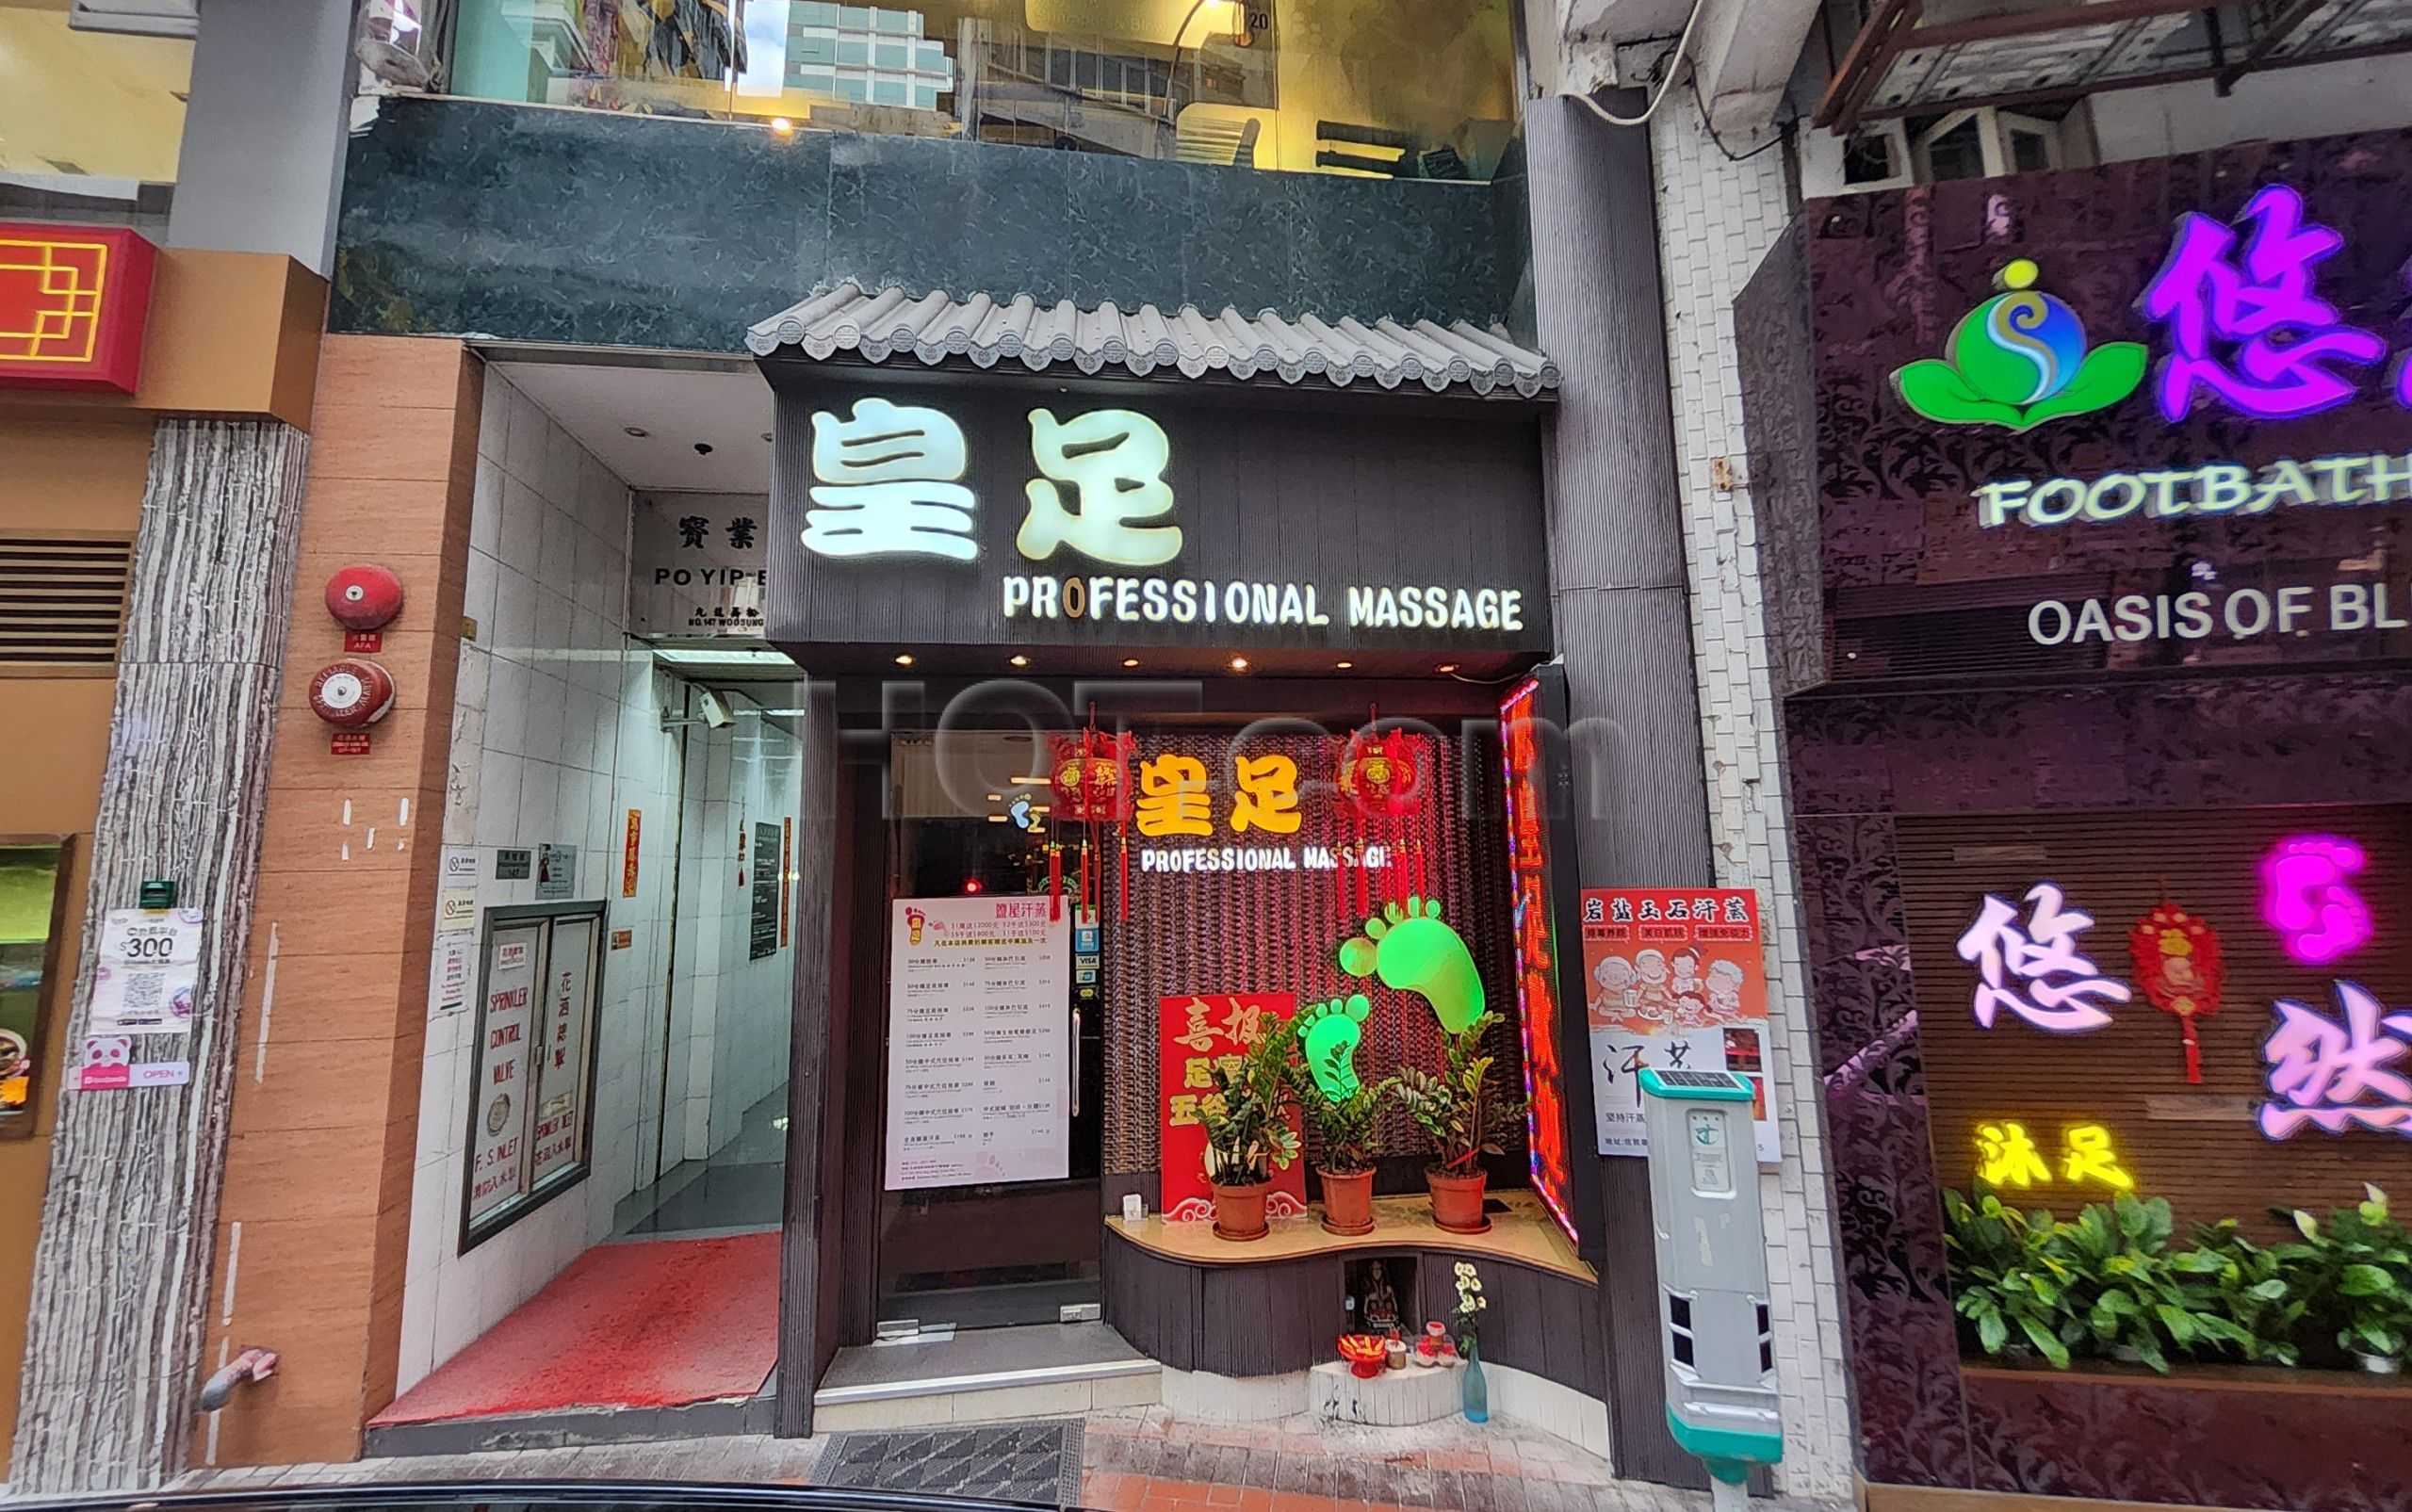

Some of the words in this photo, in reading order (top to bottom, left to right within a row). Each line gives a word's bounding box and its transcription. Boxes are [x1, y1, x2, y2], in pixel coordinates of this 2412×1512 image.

[1250, 12, 1269, 30] 20
[2141, 184, 2412, 422] 悠
[1974, 454, 2412, 528] FOOTBATH
[655, 568, 692, 586] PO
[700, 569, 744, 586] YIP
[1002, 575, 1328, 626] PROFESSIONAL
[1349, 586, 1523, 632] MASSAGE
[2028, 590, 2214, 646] OASIS
[2225, 586, 2313, 638] OF
[2330, 582, 2412, 631] BL
[1141, 848, 1296, 871] PROFESSIONAL
[1583, 897, 1751, 922] 岩盐玉石汗蒸
[1956, 881, 2132, 1032] 悠
[490, 987, 529, 1013] SPRINKLER
[490, 1023, 521, 1049] CONTROL
[143, 1069, 174, 1080] OPEN
[1974, 1121, 2135, 1190] 沐足
